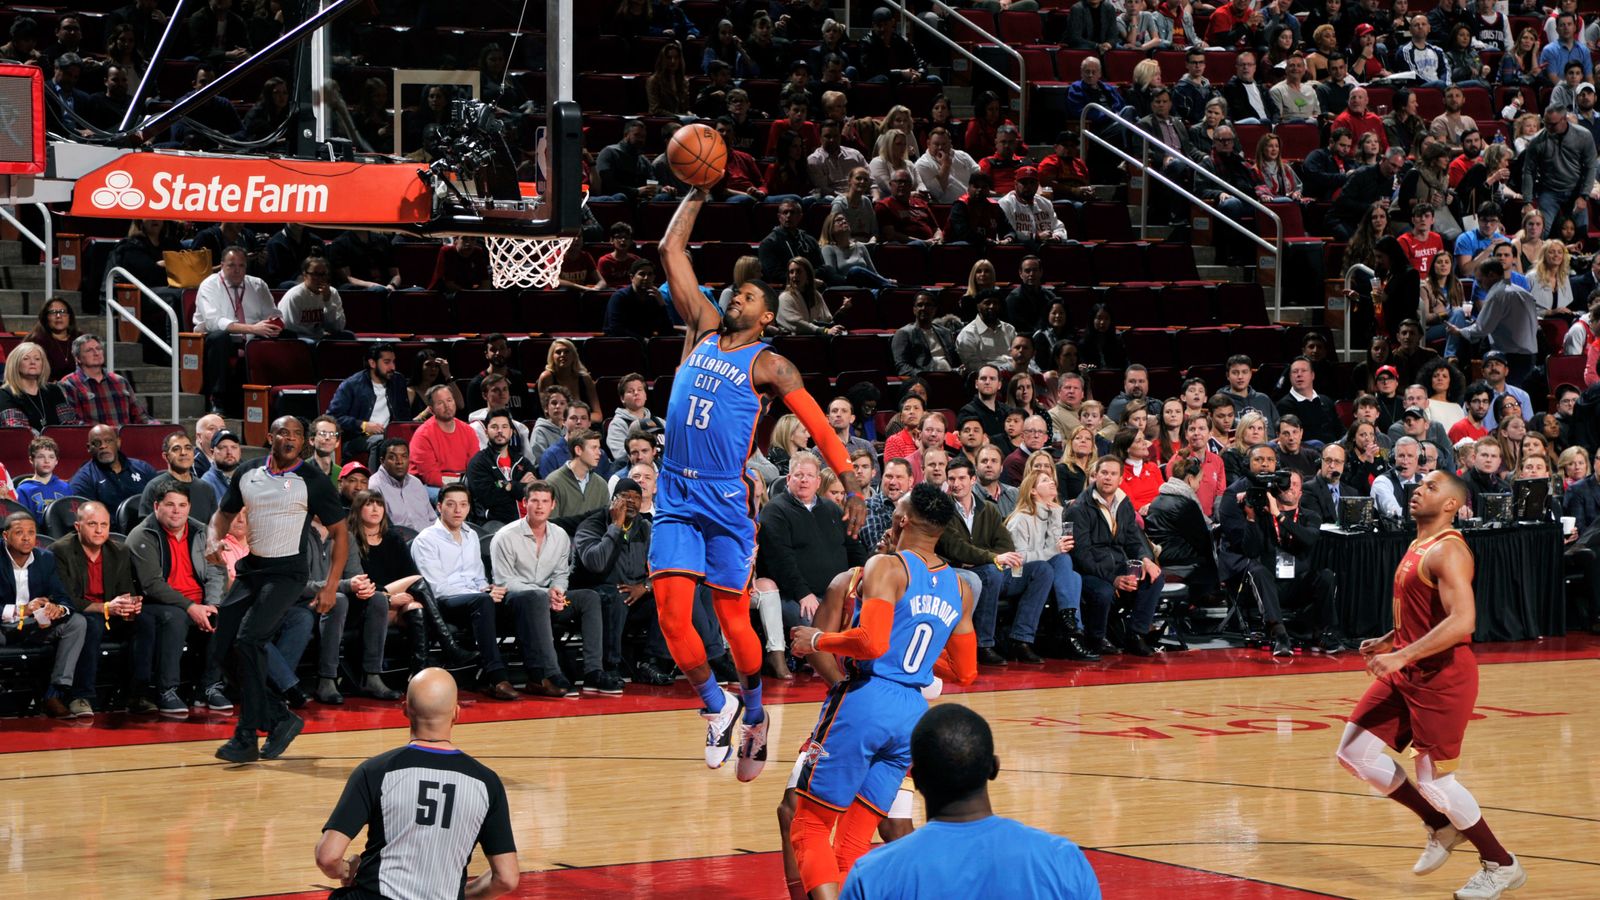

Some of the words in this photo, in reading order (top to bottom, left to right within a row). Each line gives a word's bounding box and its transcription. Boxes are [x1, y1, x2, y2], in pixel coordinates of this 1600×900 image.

[148, 171, 242, 212] State
[243, 175, 329, 213] Farm
[1015, 211, 1050, 220] HOUTON
[688, 353, 747, 387] OKLAHOMA
[694, 373, 722, 394] CITY
[686, 395, 714, 430] 13
[683, 468, 698, 479] OKC
[903, 622, 934, 675] 0
[1064, 706, 1569, 740] TOTA
[415, 780, 456, 829] 51
